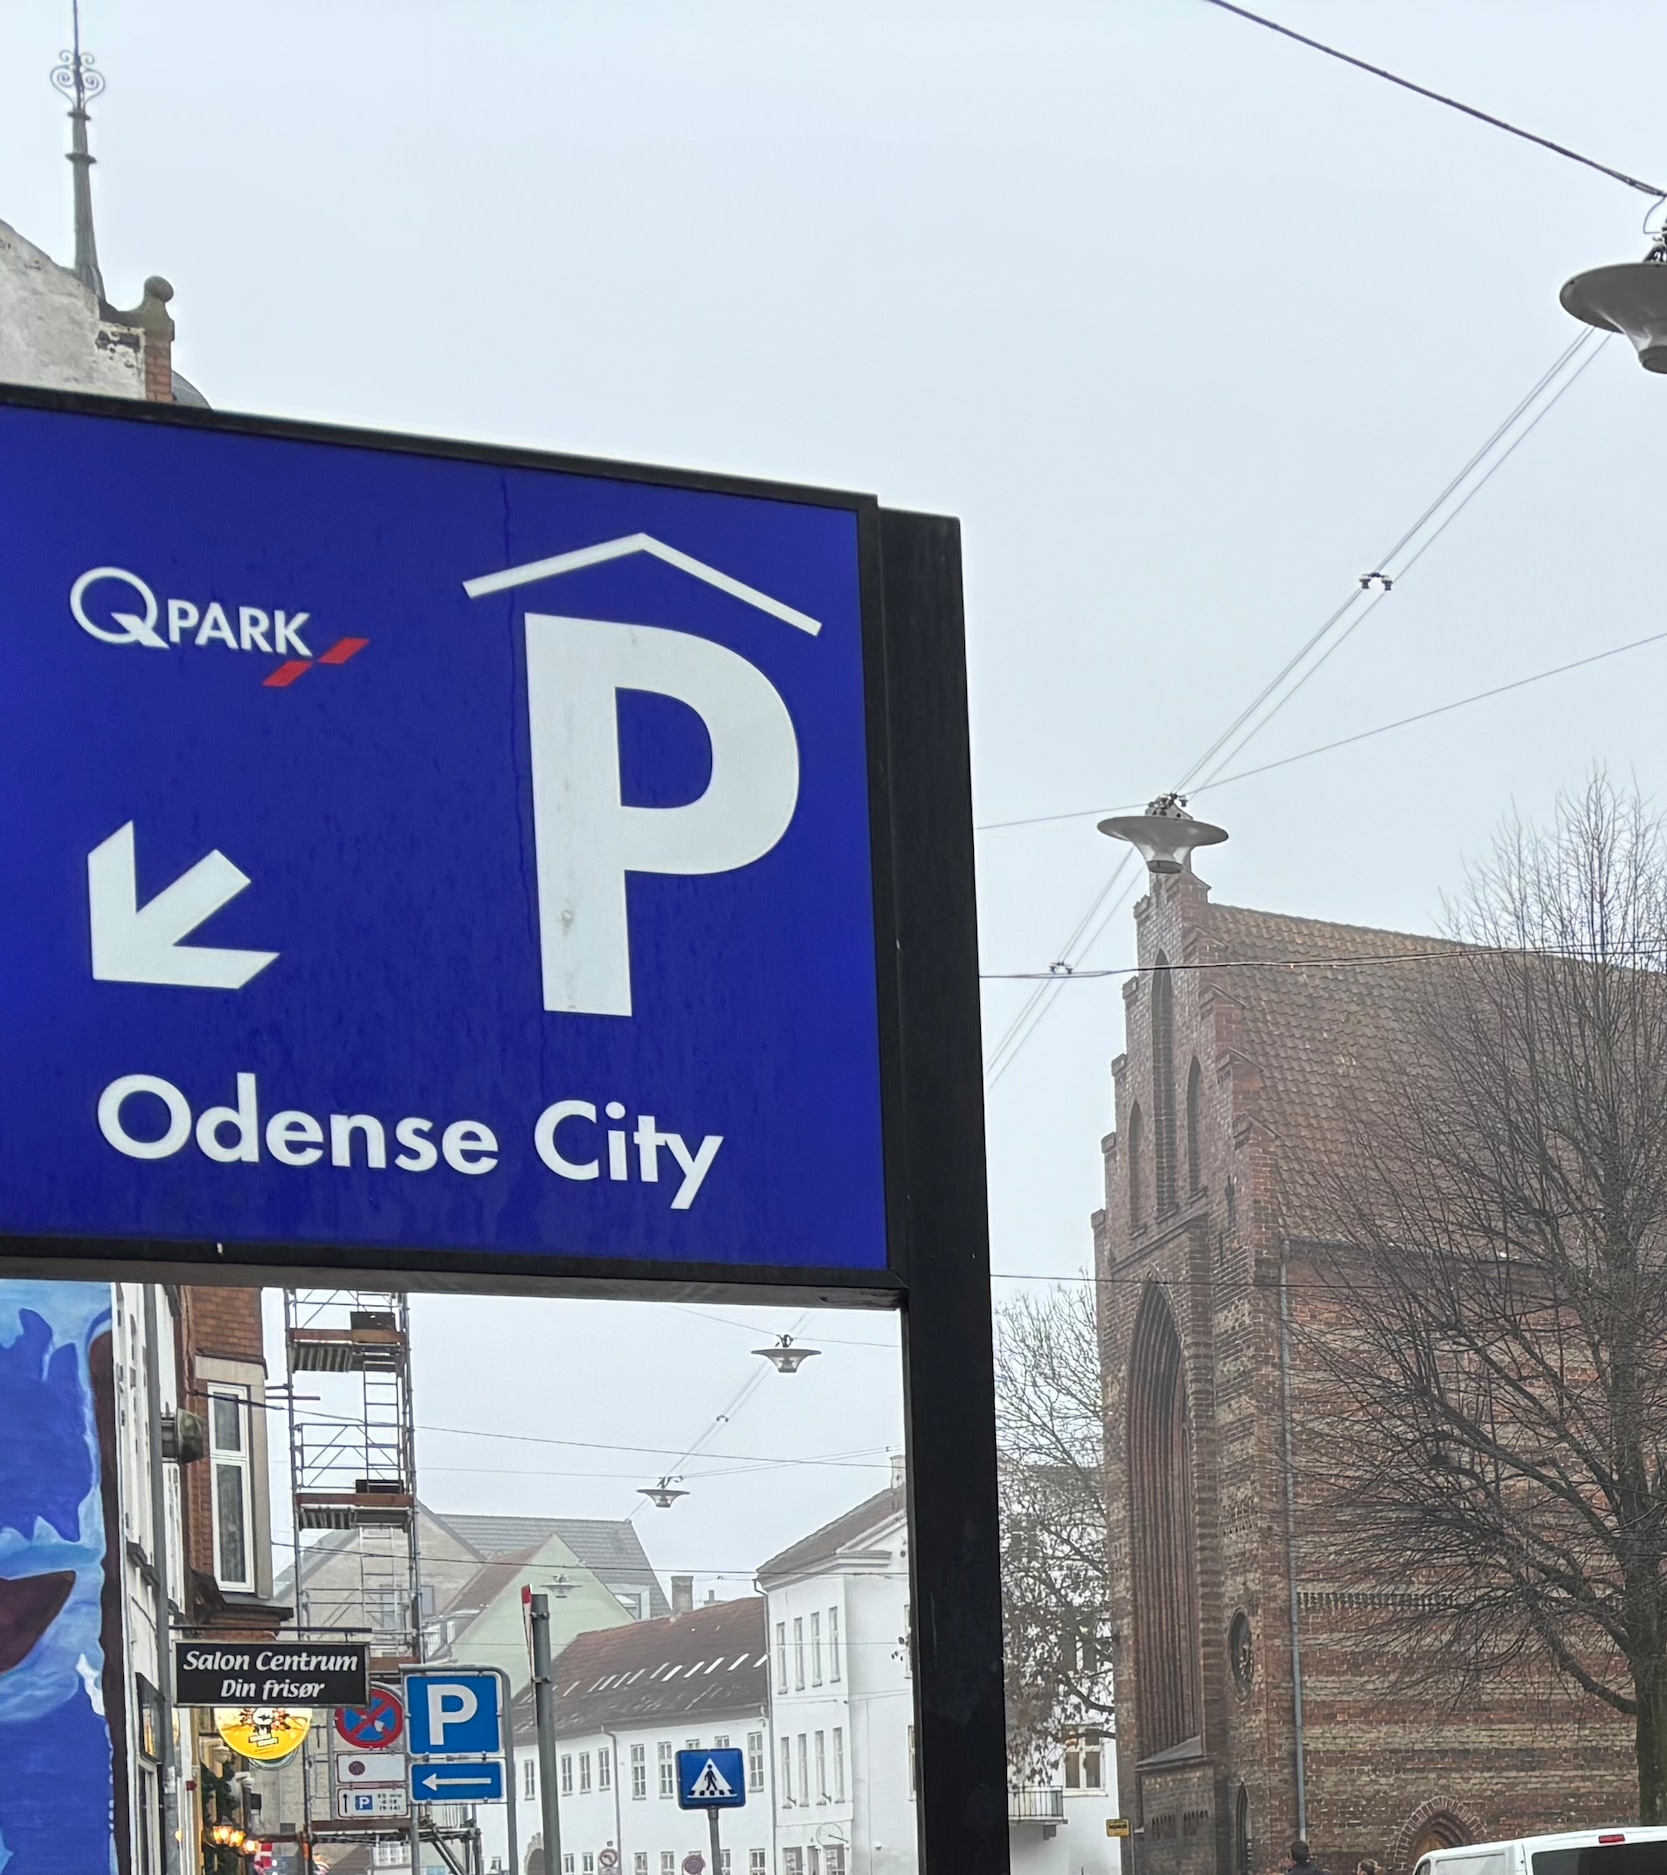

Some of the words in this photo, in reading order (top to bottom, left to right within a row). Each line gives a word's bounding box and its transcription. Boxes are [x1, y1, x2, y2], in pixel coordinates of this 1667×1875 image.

[524, 612, 800, 1017] P
[97, 1072, 499, 1174] Odense
[534, 1100, 724, 1210] City
[183, 1650, 250, 1671] Salon
[255, 1651, 359, 1672] Centrum
[220, 1679, 257, 1698] Din
[262, 1679, 326, 1701] frisør
[427, 1684, 478, 1746] P
[360, 1797, 370, 1809] P
